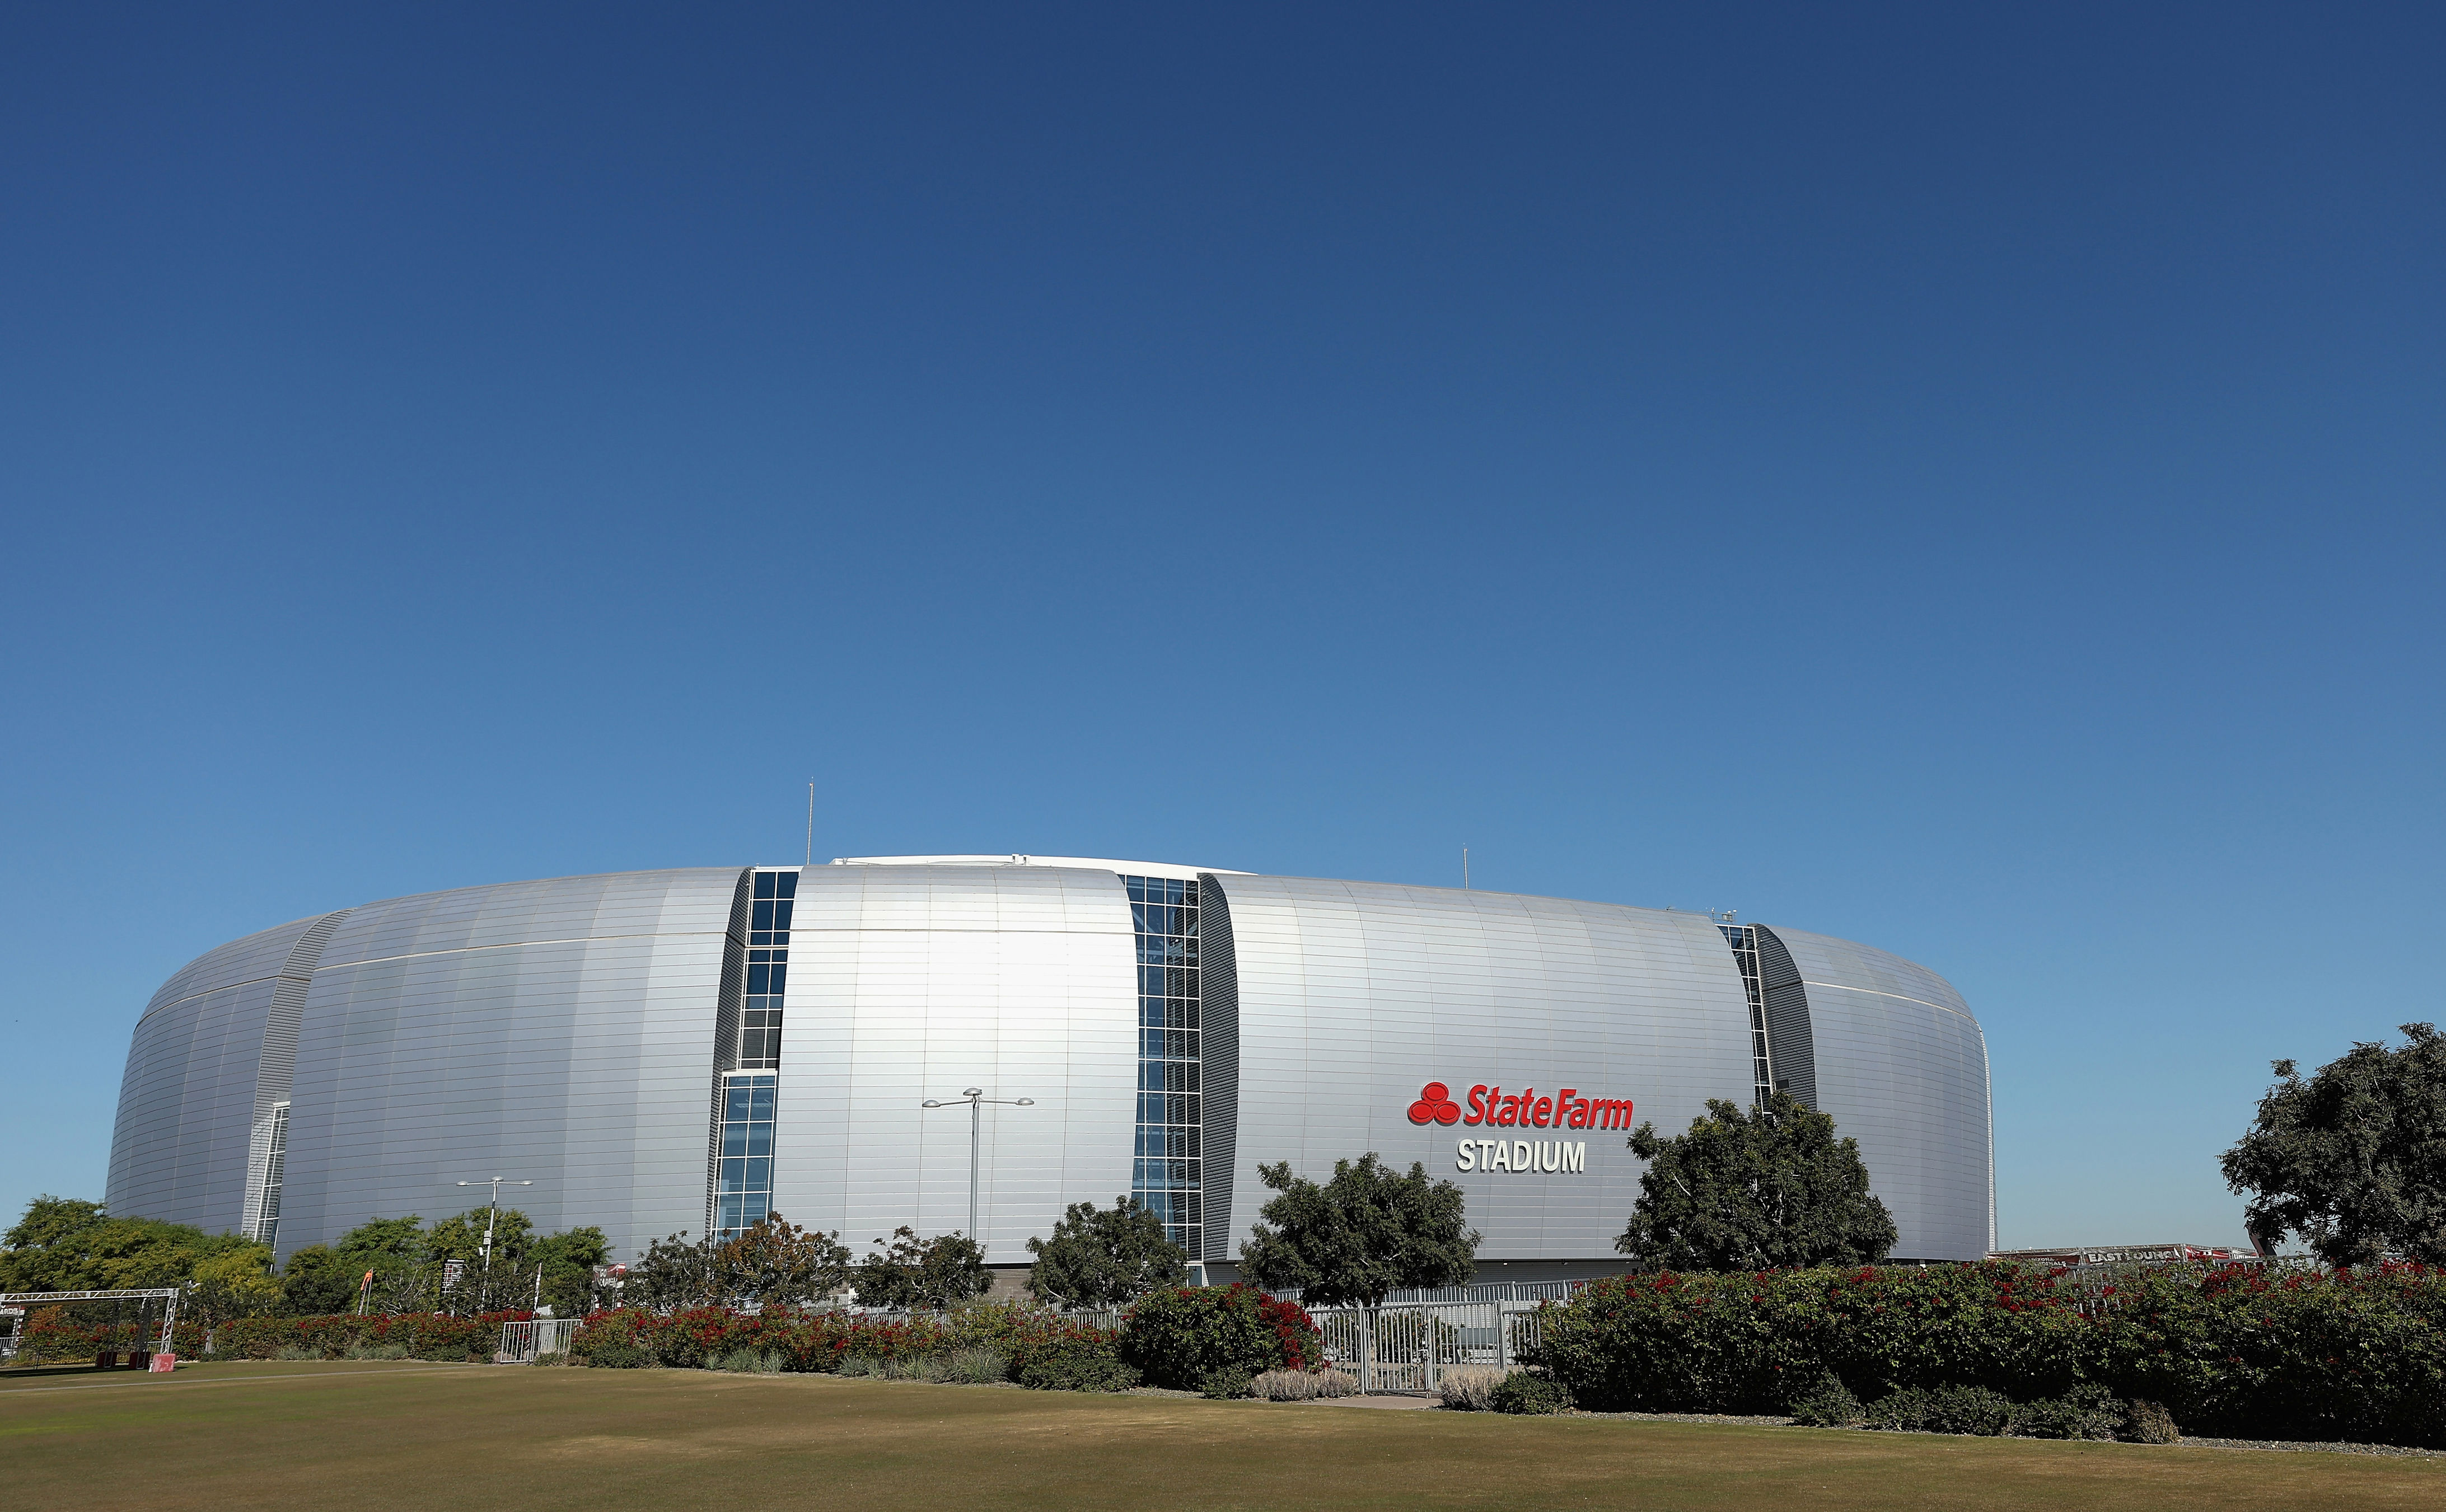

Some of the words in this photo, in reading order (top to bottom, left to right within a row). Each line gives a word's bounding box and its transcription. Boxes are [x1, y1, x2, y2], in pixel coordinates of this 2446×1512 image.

[1457, 1139, 1586, 1172] STADIUM
[2088, 1252, 2124, 1262] EAST
[2124, 1249, 2177, 1260] LOUNG
[600, 1268, 607, 1277] GO
